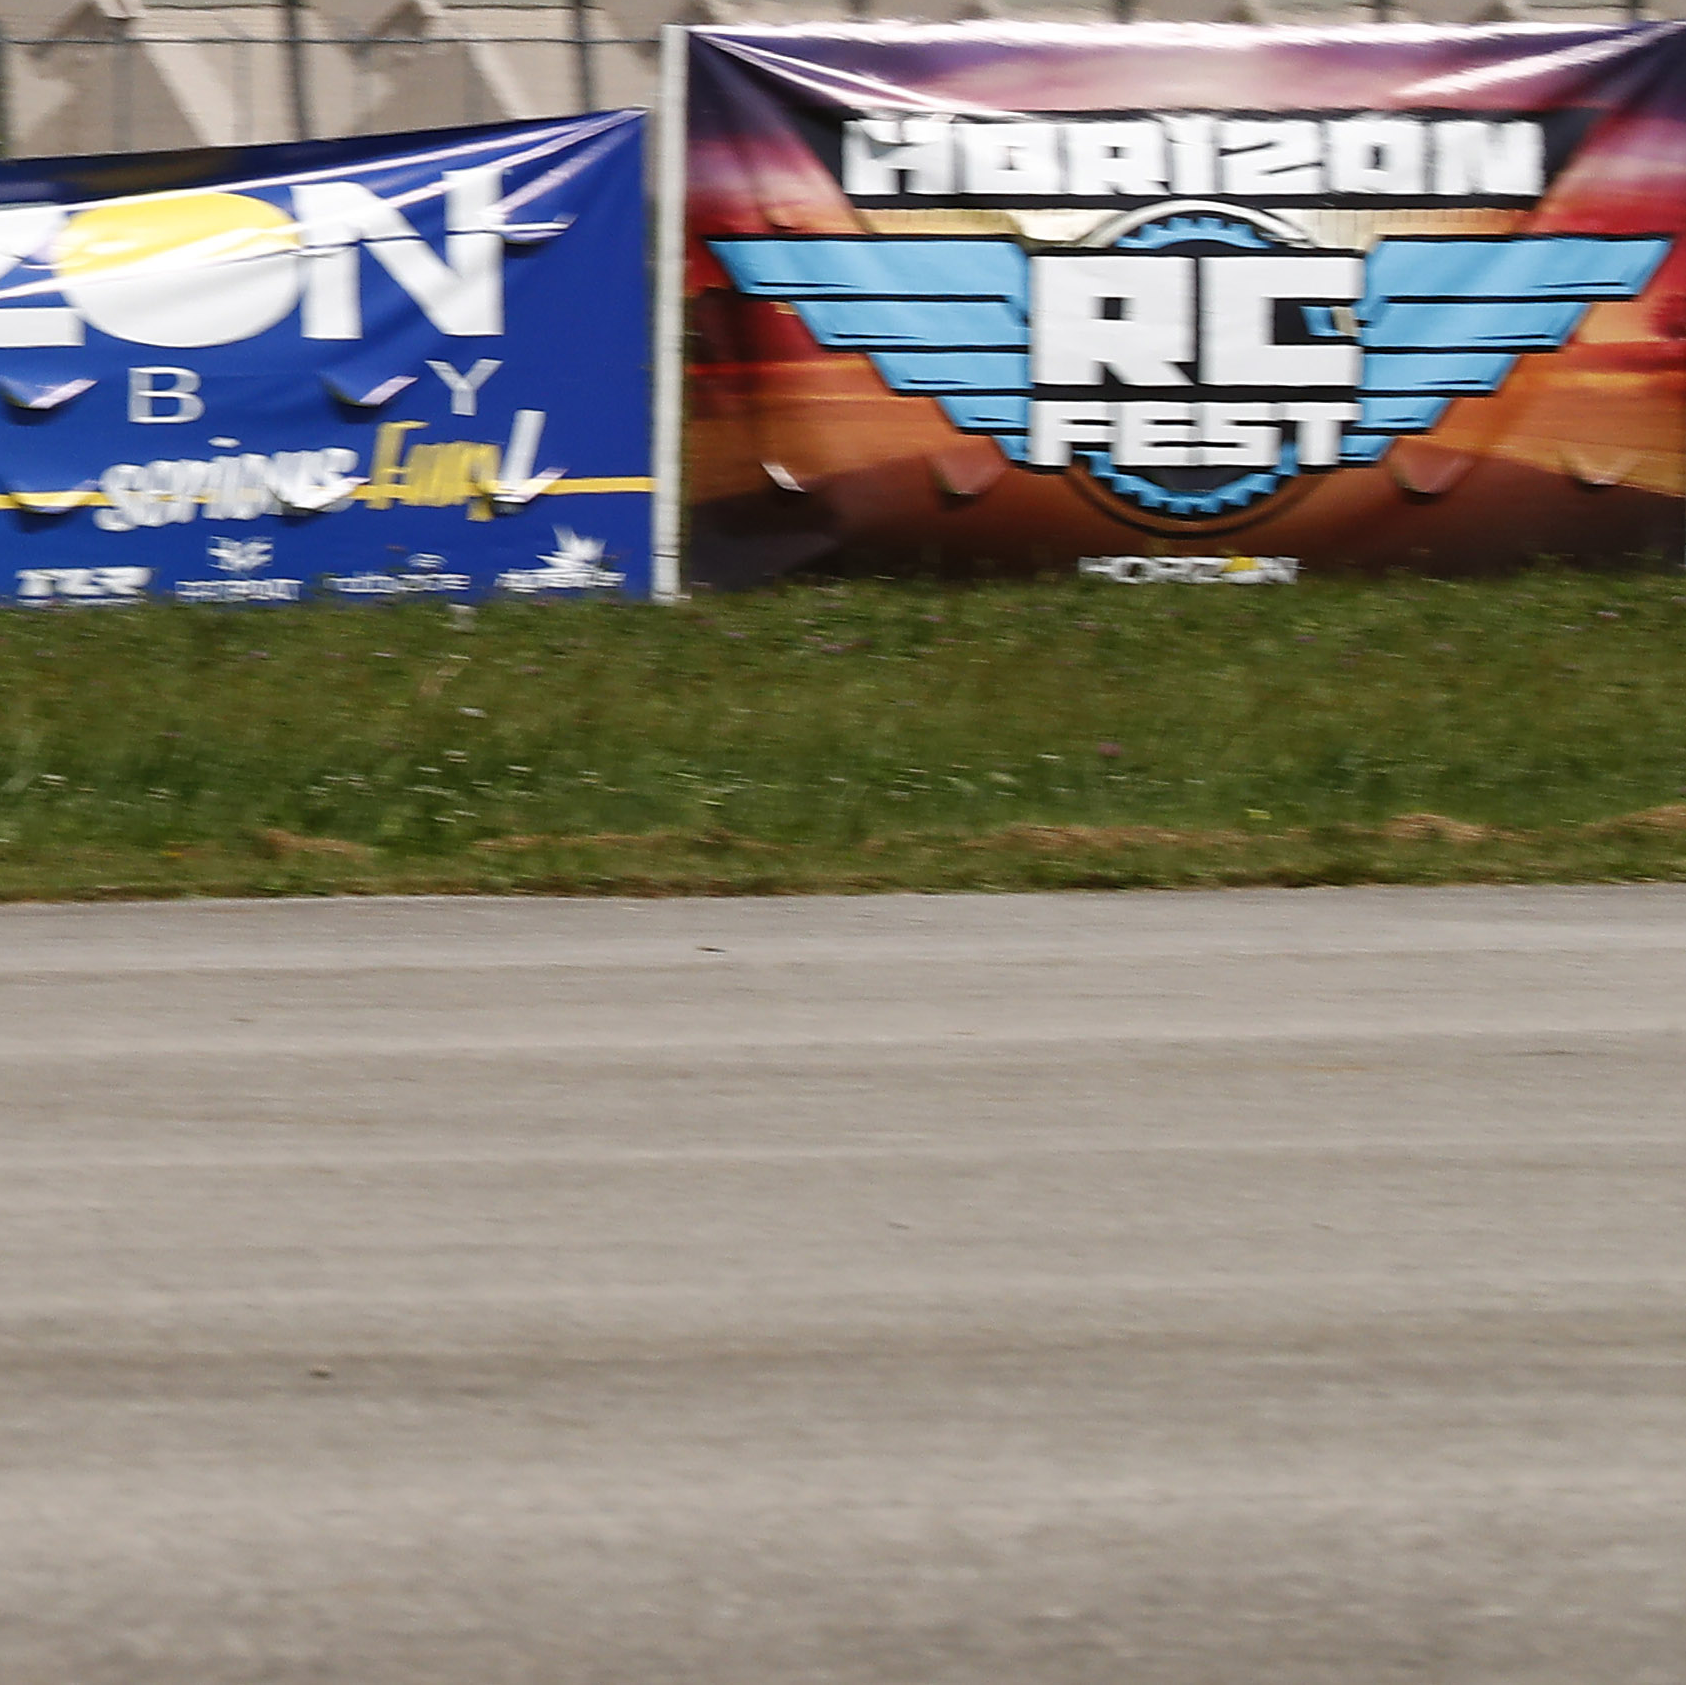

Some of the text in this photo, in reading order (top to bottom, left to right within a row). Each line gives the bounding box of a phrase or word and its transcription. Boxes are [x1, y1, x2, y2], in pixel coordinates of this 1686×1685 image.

[843, 116, 1545, 197] HORIZON
[1028, 254, 1366, 388] RC
[1028, 400, 1363, 468] FEST
